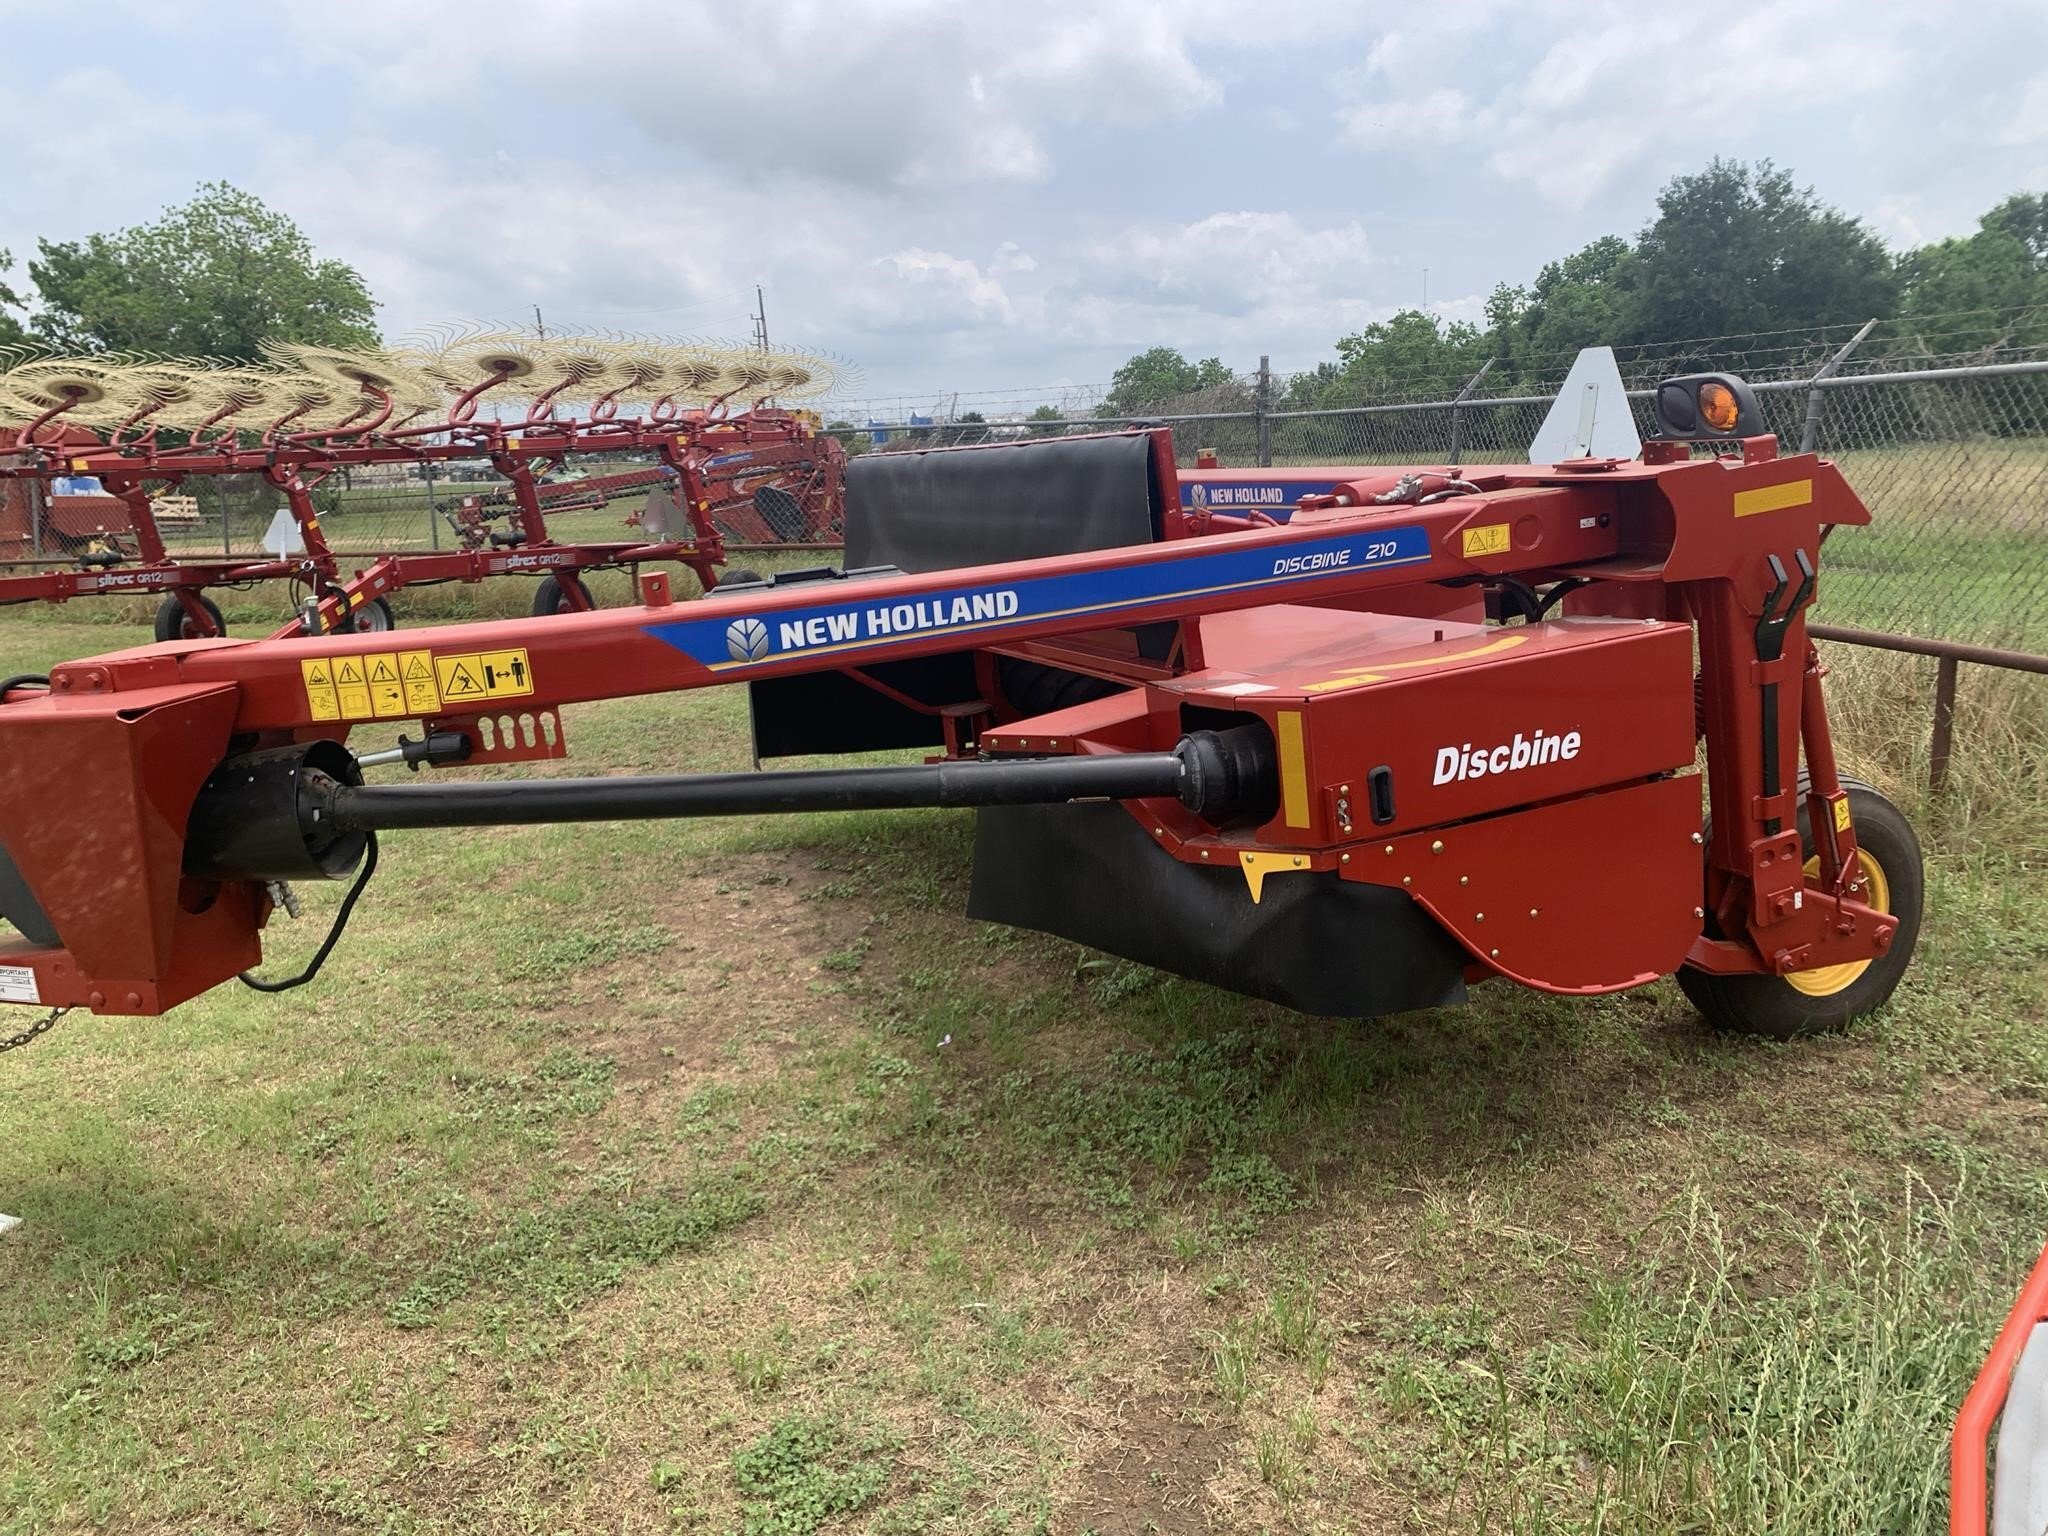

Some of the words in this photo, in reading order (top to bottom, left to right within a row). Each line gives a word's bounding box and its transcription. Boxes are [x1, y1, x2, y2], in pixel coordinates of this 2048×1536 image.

[1210, 488, 1233, 503] NEW
[1235, 488, 1283, 503] HOLLAND
[1273, 549, 1351, 575] DISCBINE
[1365, 541, 1397, 560] 210
[780, 612, 858, 650] NEW
[867, 590, 1019, 636] HOLLAND
[1432, 729, 1581, 786] Discbine
